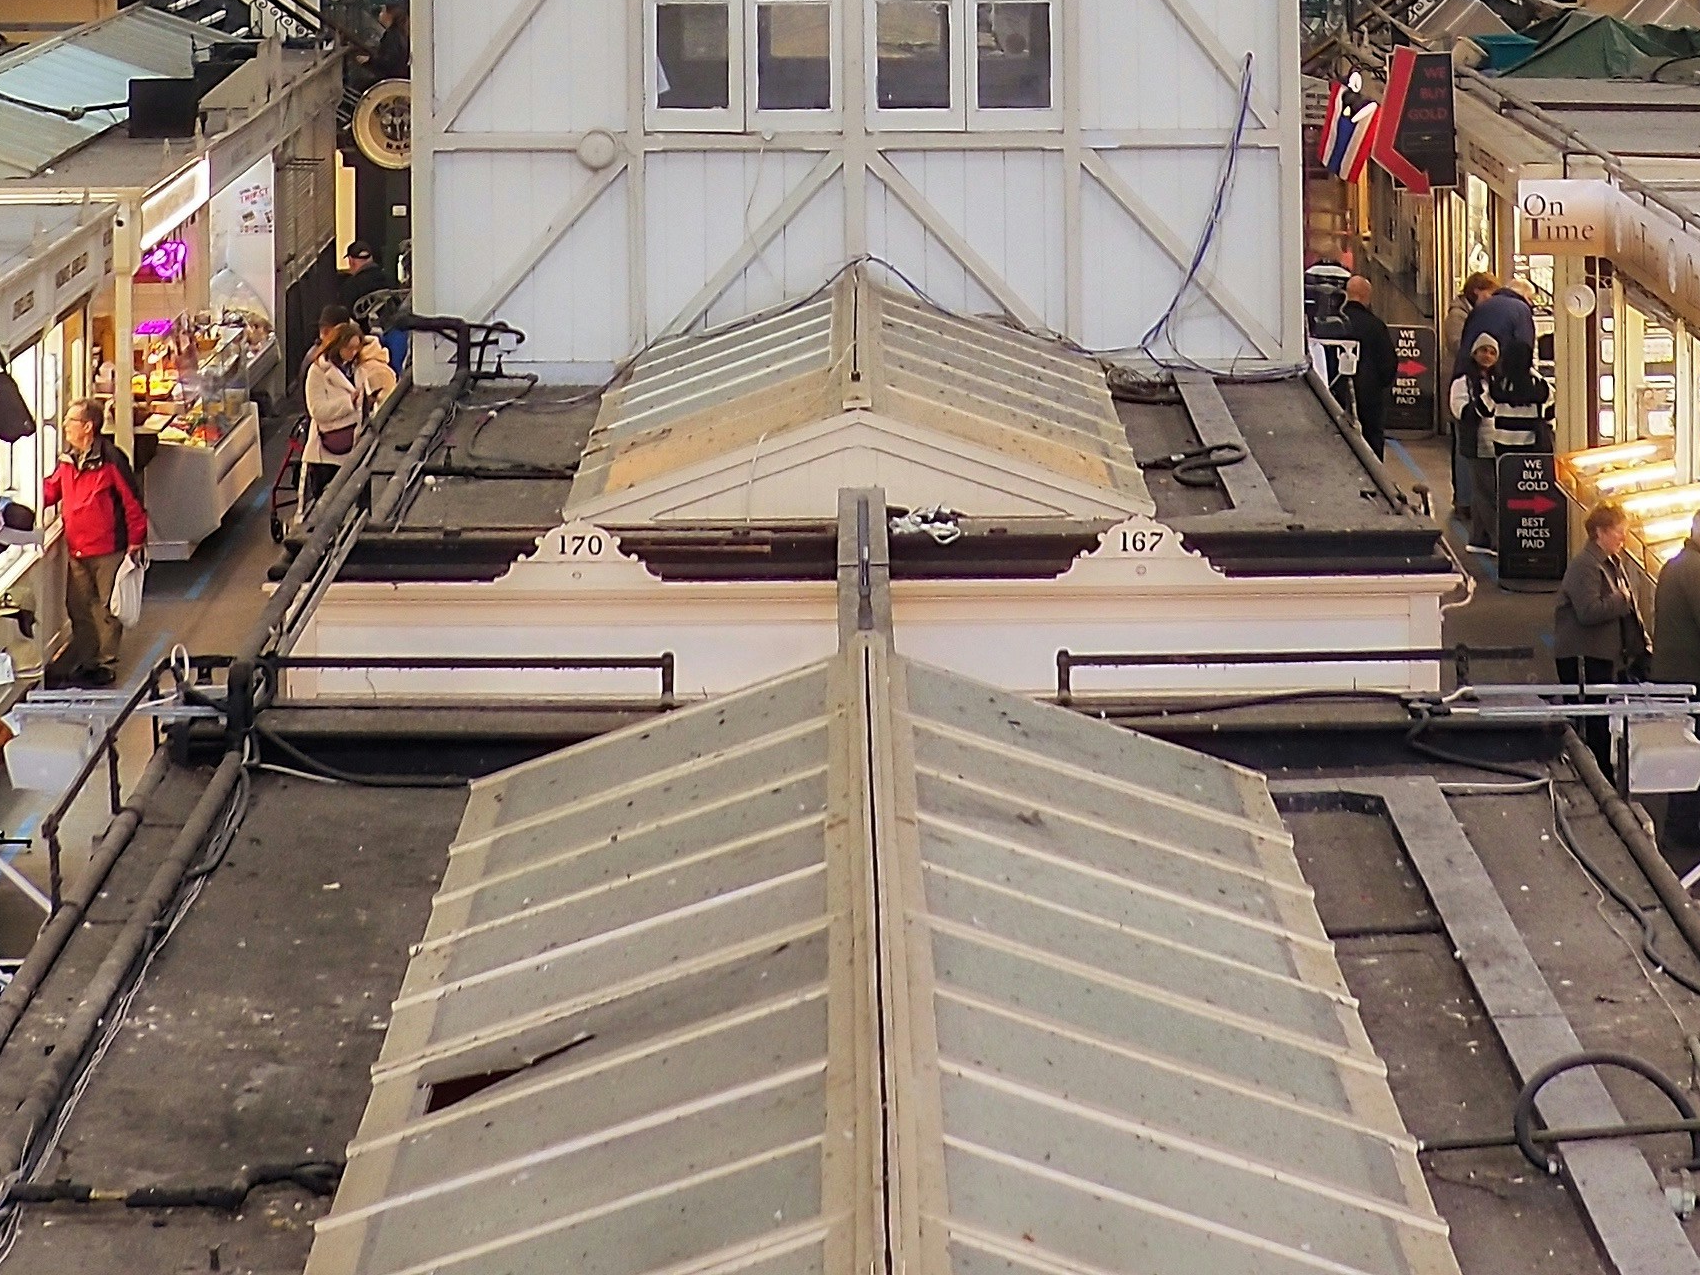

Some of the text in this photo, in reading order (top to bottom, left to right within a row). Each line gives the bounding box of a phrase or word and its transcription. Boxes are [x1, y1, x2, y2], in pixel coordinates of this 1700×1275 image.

[1424, 67, 1447, 79] WE
[1419, 86, 1447, 99] BUY
[1407, 107, 1448, 121] GOLD
[1523, 193, 1565, 218] On
[1524, 216, 1595, 241] Time
[1399, 329, 1416, 339] WE
[1398, 339, 1418, 349] BUY
[1396, 347, 1421, 357] GOLD
[1396, 378, 1418, 387] BEST
[1392, 386, 1421, 396] PRICES
[1396, 396, 1416, 405] PAID
[1524, 459, 1543, 470] WE
[1522, 469, 1545, 481] BUY
[1517, 481, 1550, 492] GOLD
[1521, 517, 1546, 528] BEST
[1516, 527, 1551, 539] PRICES
[559, 534, 603, 556] 170
[1121, 530, 1164, 552] 167
[1521, 538, 1546, 550] PAID
